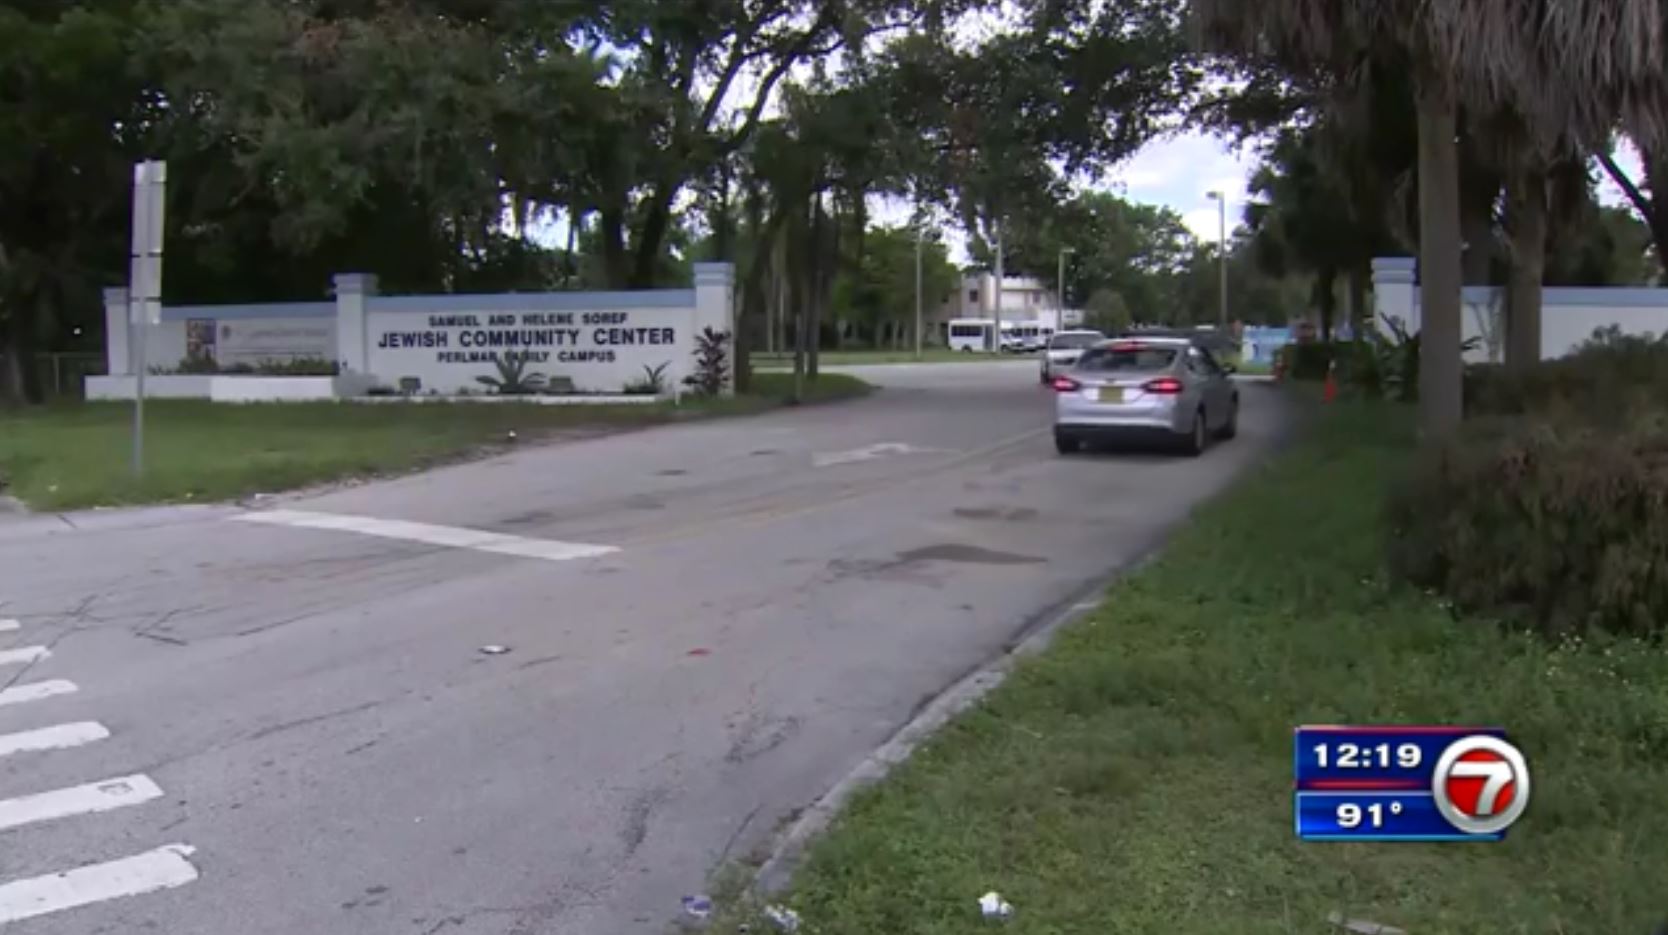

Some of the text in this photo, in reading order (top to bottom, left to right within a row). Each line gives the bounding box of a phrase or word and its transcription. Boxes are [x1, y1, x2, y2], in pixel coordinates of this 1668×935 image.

[428, 311, 628, 327] SAMUEL AND HELENE SOREF
[378, 327, 675, 348] JEWISH COMMUNITY CENTER
[437, 351, 498, 363] PERLMAN
[557, 350, 616, 363] CAMPUS
